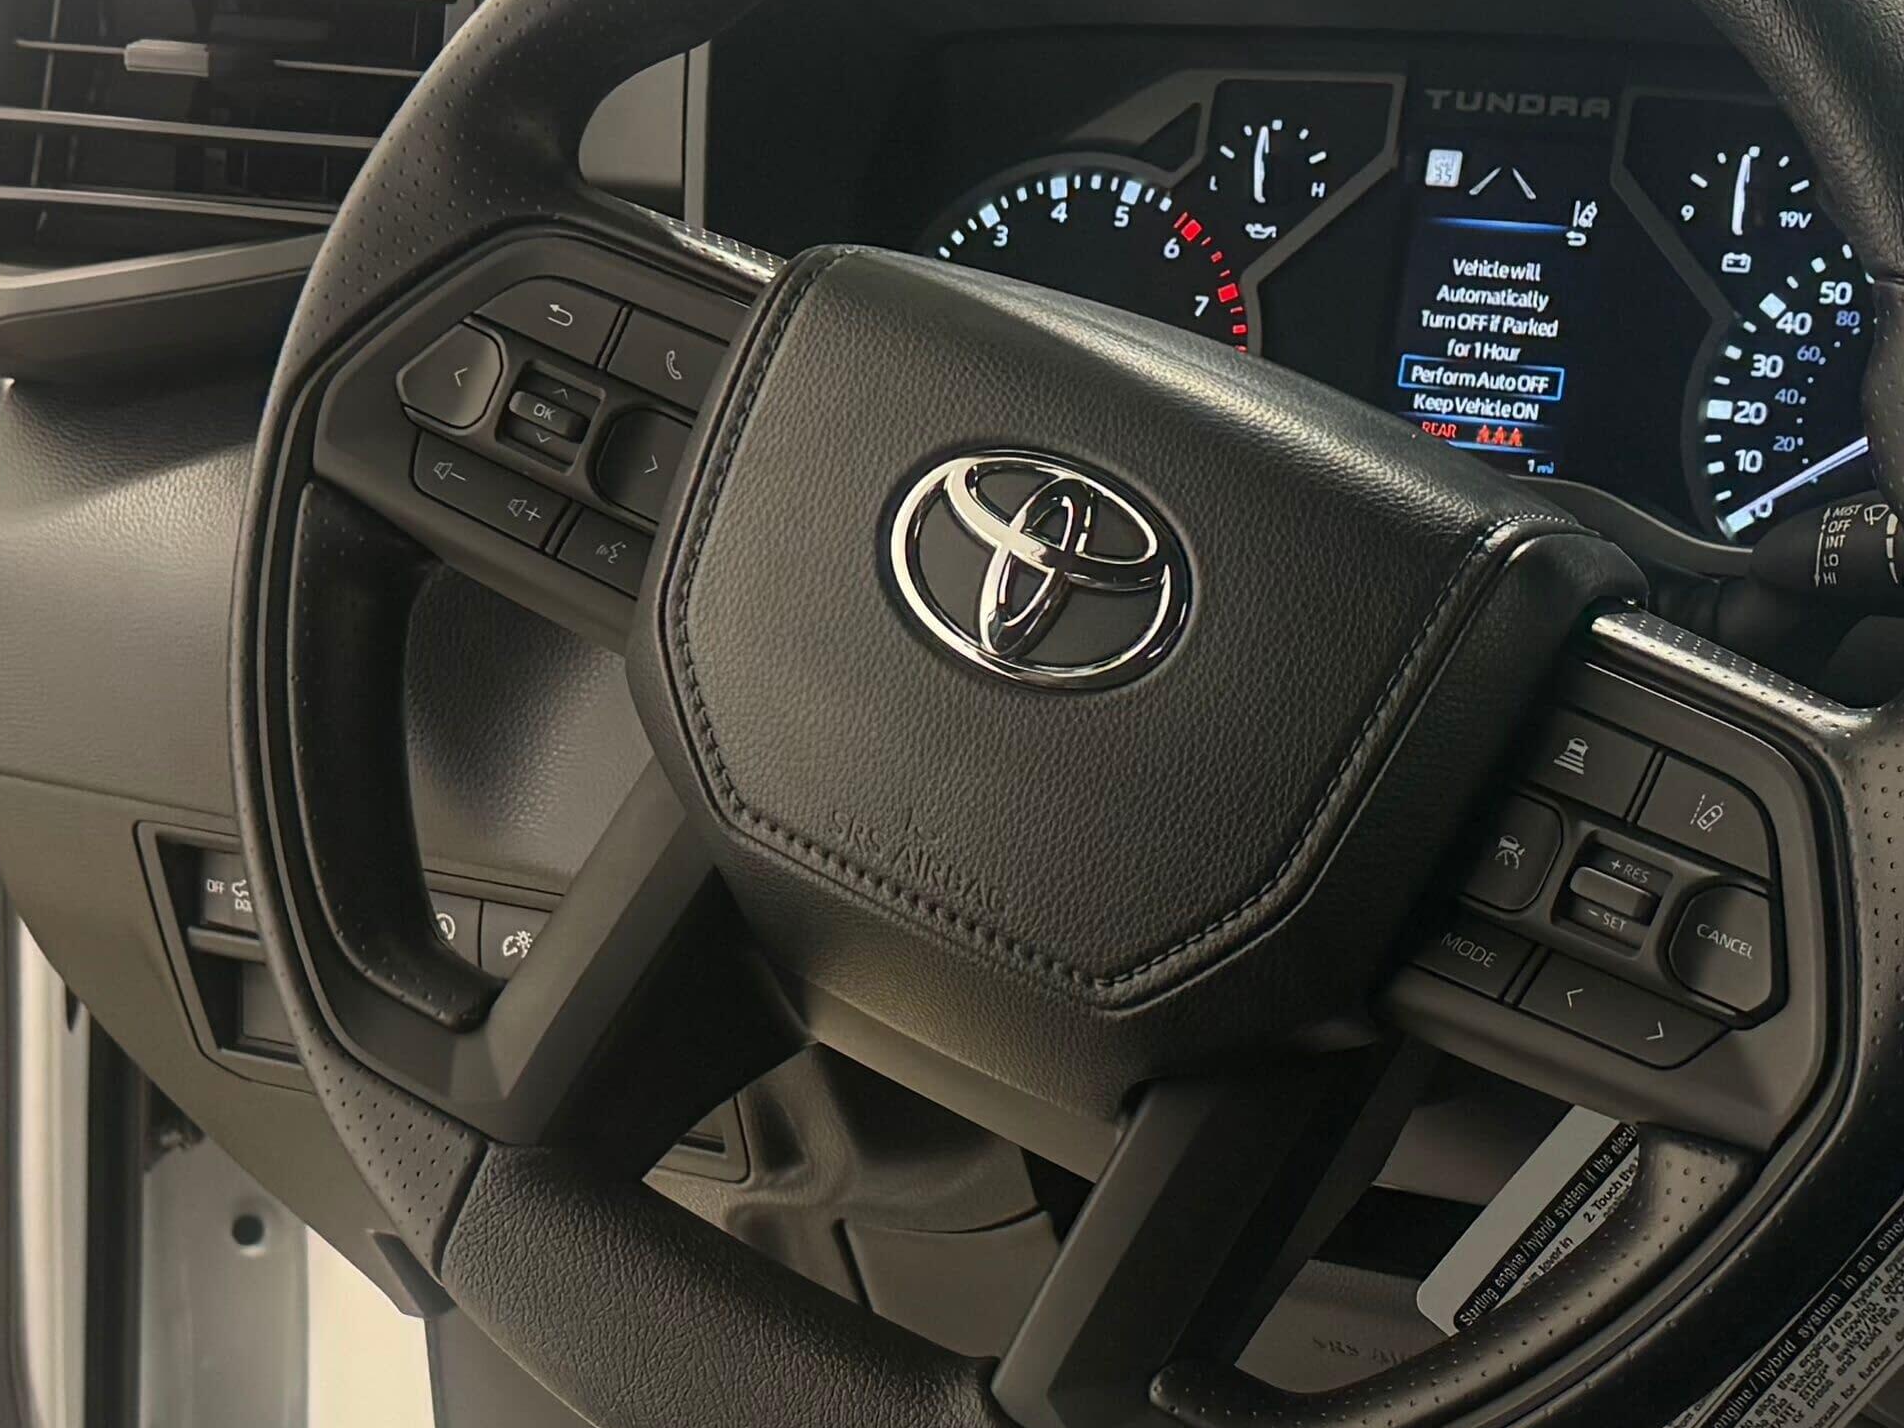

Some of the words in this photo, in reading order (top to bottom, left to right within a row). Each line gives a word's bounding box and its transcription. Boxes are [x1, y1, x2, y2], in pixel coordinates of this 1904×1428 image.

[1425, 89, 1610, 119] TUNDRA
[1209, 175, 1218, 191] L
[1311, 182, 1326, 199] H
[1050, 202, 1069, 223] 4
[1114, 205, 1131, 228] 5
[1680, 205, 1695, 222] 9
[1779, 211, 1812, 229] 19V
[993, 225, 1010, 248] 3
[1163, 238, 1181, 260] 6
[1452, 258, 1509, 281] Vehicle
[1510, 260, 1542, 282] will
[1436, 285, 1550, 313] Automatically
[1819, 281, 1853, 306] 50
[1195, 294, 1210, 317] 7
[1420, 310, 1458, 330] Turn
[1458, 314, 1489, 333] OFF
[1490, 315, 1502, 333] if
[1503, 316, 1560, 339] Parked
[1776, 312, 1813, 336] 40
[1835, 311, 1860, 327] 80
[1447, 338, 1473, 358] for
[1474, 341, 1483, 359] 1
[1483, 342, 1522, 363] Hour
[1797, 346, 1820, 362] 60
[1750, 354, 1784, 379] 30
[1411, 365, 1476, 388] Perform
[1476, 371, 1517, 393] Auto
[1517, 374, 1550, 394] OFF
[1413, 393, 1454, 415] Keep
[1454, 397, 1513, 419] Vehicle
[1513, 401, 1539, 421] ON
[1774, 390, 1798, 405] 40
[532, 404, 556, 422] OK
[1733, 401, 1767, 425] 20
[1421, 421, 1457, 439] REAR
[1773, 436, 1795, 452] 20
[1527, 459, 1535, 473] 1
[1734, 450, 1762, 472] 10
[1832, 504, 1863, 517] MIST
[1828, 519, 1852, 533] OFF
[1825, 534, 1846, 549] INT
[1823, 554, 1839, 567] LO
[1823, 572, 1837, 585] HI
[1623, 862, 1650, 884] RES
[206, 879, 226, 895] OFF
[1601, 913, 1627, 933] SET
[1441, 932, 1497, 968] MODE
[1696, 922, 1753, 960] CANCEL
[1591, 1178, 1623, 1213] Touch
[1457, 1284, 1500, 1330] Starting
[1552, 1179, 1592, 1221] system
[1582, 1168, 1598, 1184] if
[1591, 1150, 1614, 1174] the
[1559, 1235, 1574, 1250] in
[1796, 1290, 1844, 1342] system
[1838, 1270, 1858, 1290] in
[1855, 1253, 1876, 1274] an
[1754, 1392, 1779, 1419] stop
[1777, 1370, 1797, 1392] the
